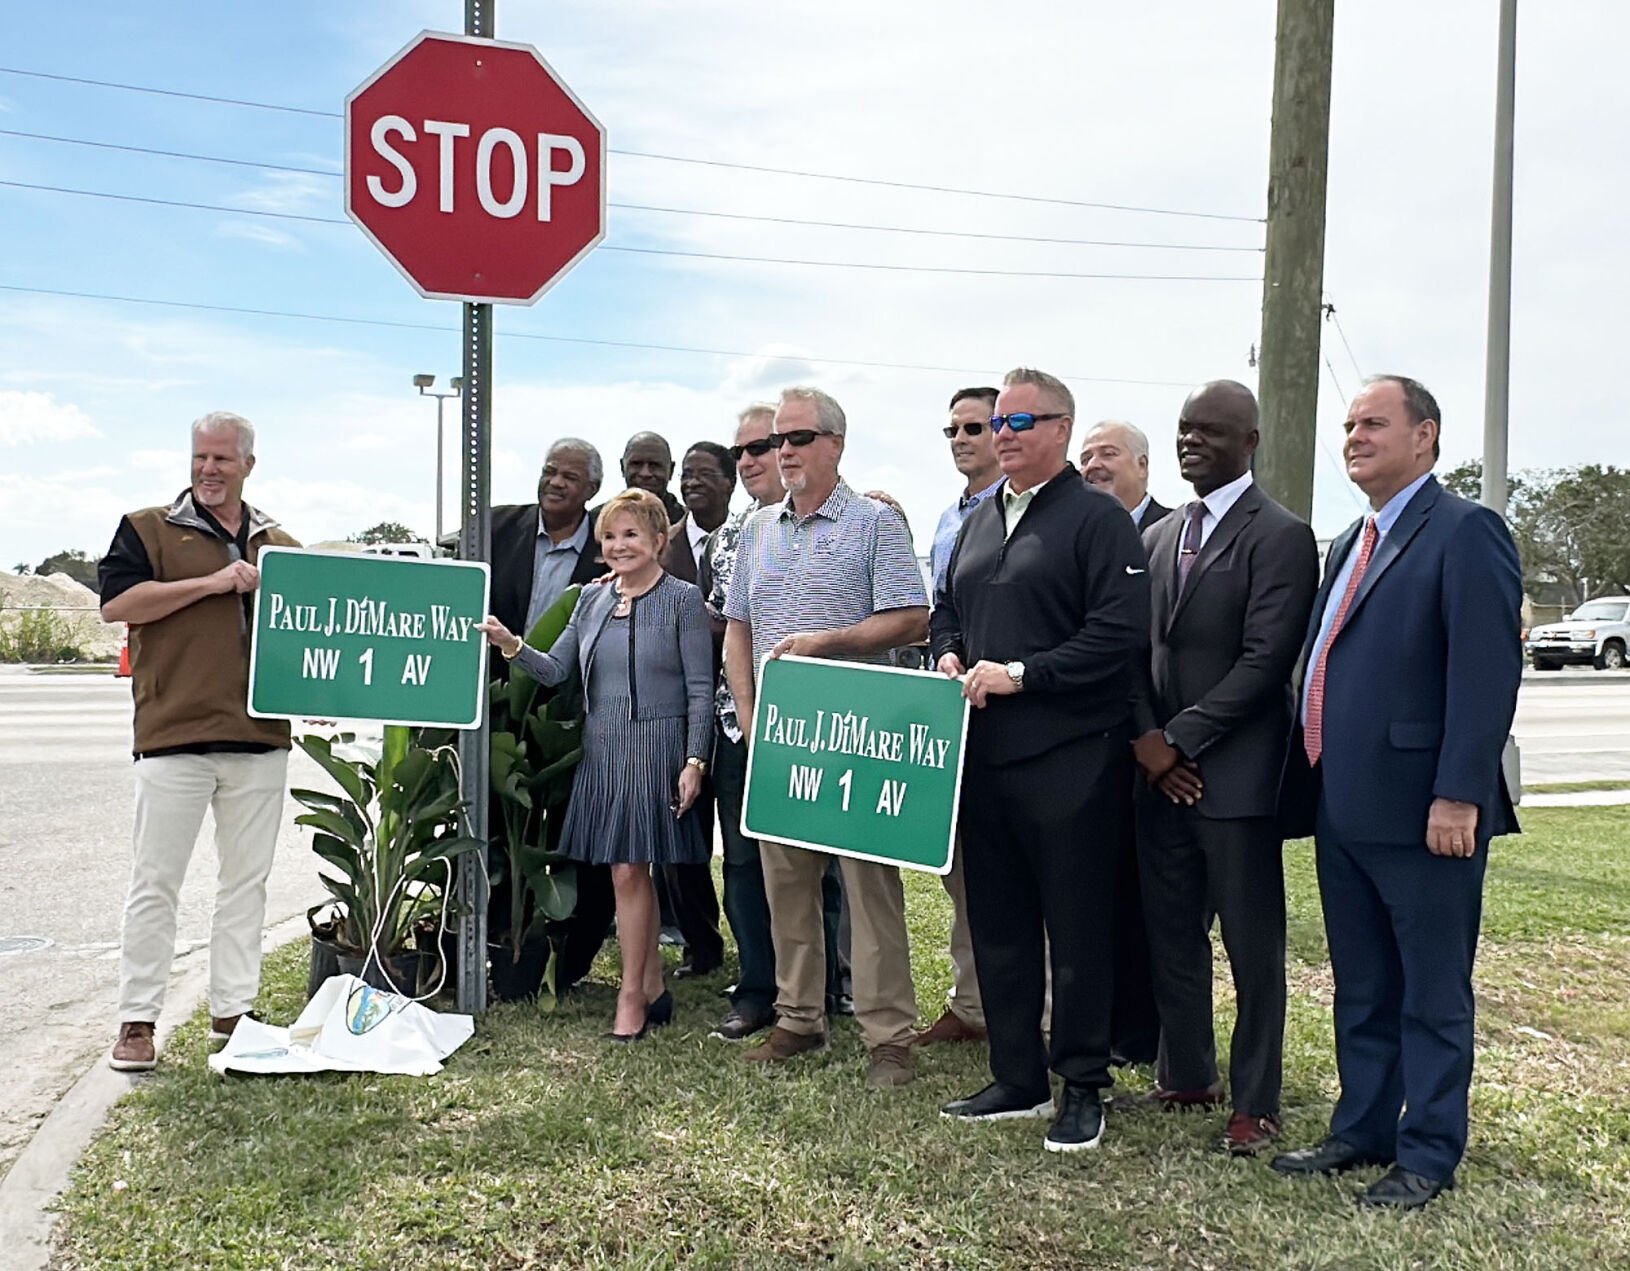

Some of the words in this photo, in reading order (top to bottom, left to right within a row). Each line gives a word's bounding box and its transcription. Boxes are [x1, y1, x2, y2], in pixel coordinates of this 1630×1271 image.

[366, 114, 586, 222] STOP
[324, 597, 341, 637] J.
[430, 604, 473, 642] WAY
[302, 647, 341, 680] NW
[358, 647, 374, 685] 1
[401, 654, 432, 685] AV
[810, 710, 826, 754] J.
[909, 723, 951, 769] WAY
[788, 763, 824, 802] NW
[838, 768, 853, 812] 1
[875, 779, 907, 817] AV
